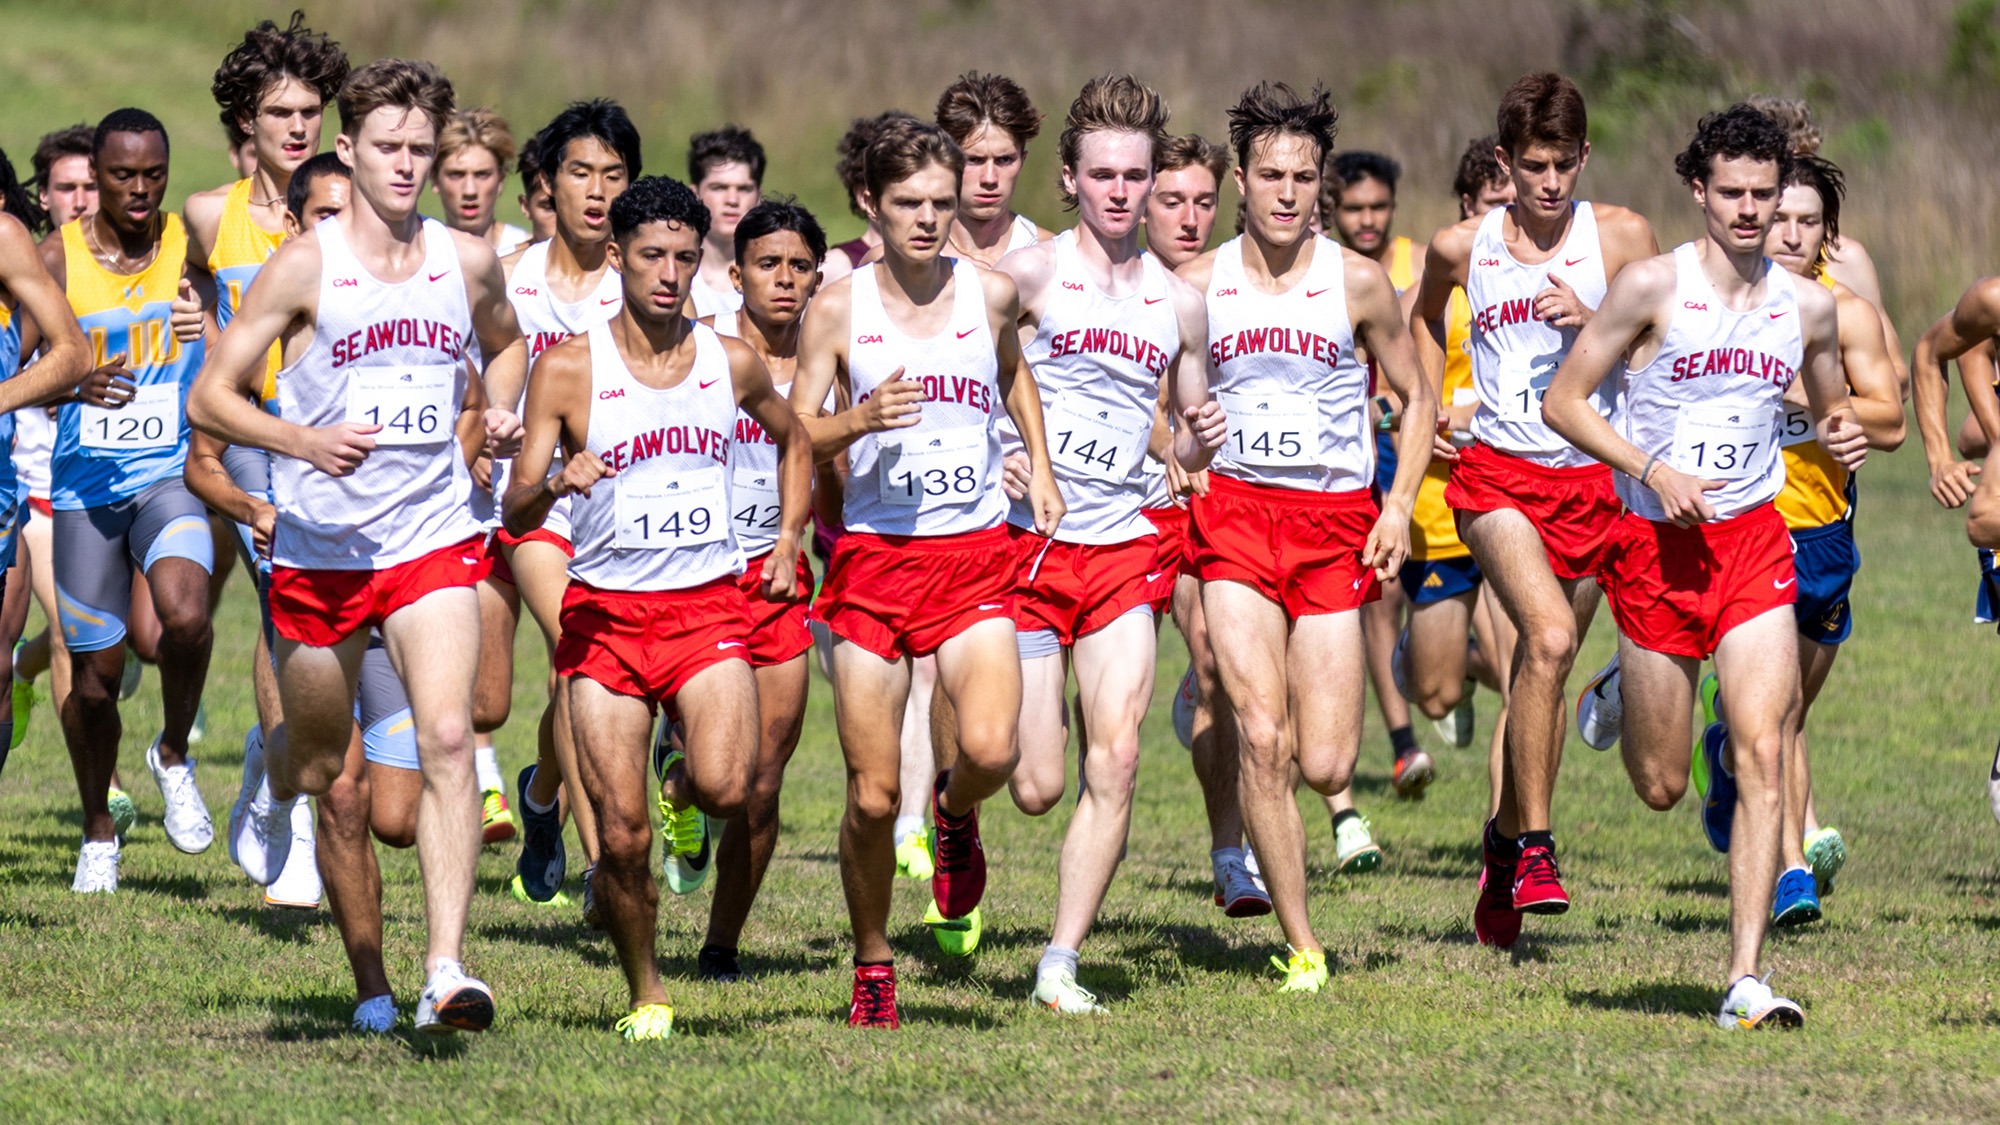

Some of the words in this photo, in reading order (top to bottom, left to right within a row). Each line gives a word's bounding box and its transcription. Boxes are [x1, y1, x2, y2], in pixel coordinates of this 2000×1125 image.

[1478, 258, 1499, 267] CAA
[333, 278, 358, 287] CAA
[515, 287, 537, 296] CAA
[1062, 281, 1084, 292] CAA
[1216, 288, 1237, 297] CAA
[1684, 301, 1708, 311] CAA
[88, 317, 182, 370] LIU
[332, 318, 462, 368] SEAWOLVES
[857, 335, 883, 344] CAA
[1049, 328, 1168, 379] SEAWOLVES
[1211, 327, 1339, 368] SEAWOLVES
[1671, 347, 1794, 394] SEAWOLVES
[599, 388, 625, 400] CAA
[96, 416, 163, 441] 120
[364, 404, 438, 434] 146
[1779, 411, 1809, 437] 5
[600, 426, 729, 472] SEAWOLVES
[1057, 431, 1117, 471] 144
[1232, 429, 1301, 457] 145
[1691, 441, 1759, 470] 137
[898, 465, 976, 496] 138
[633, 507, 711, 540] 149
